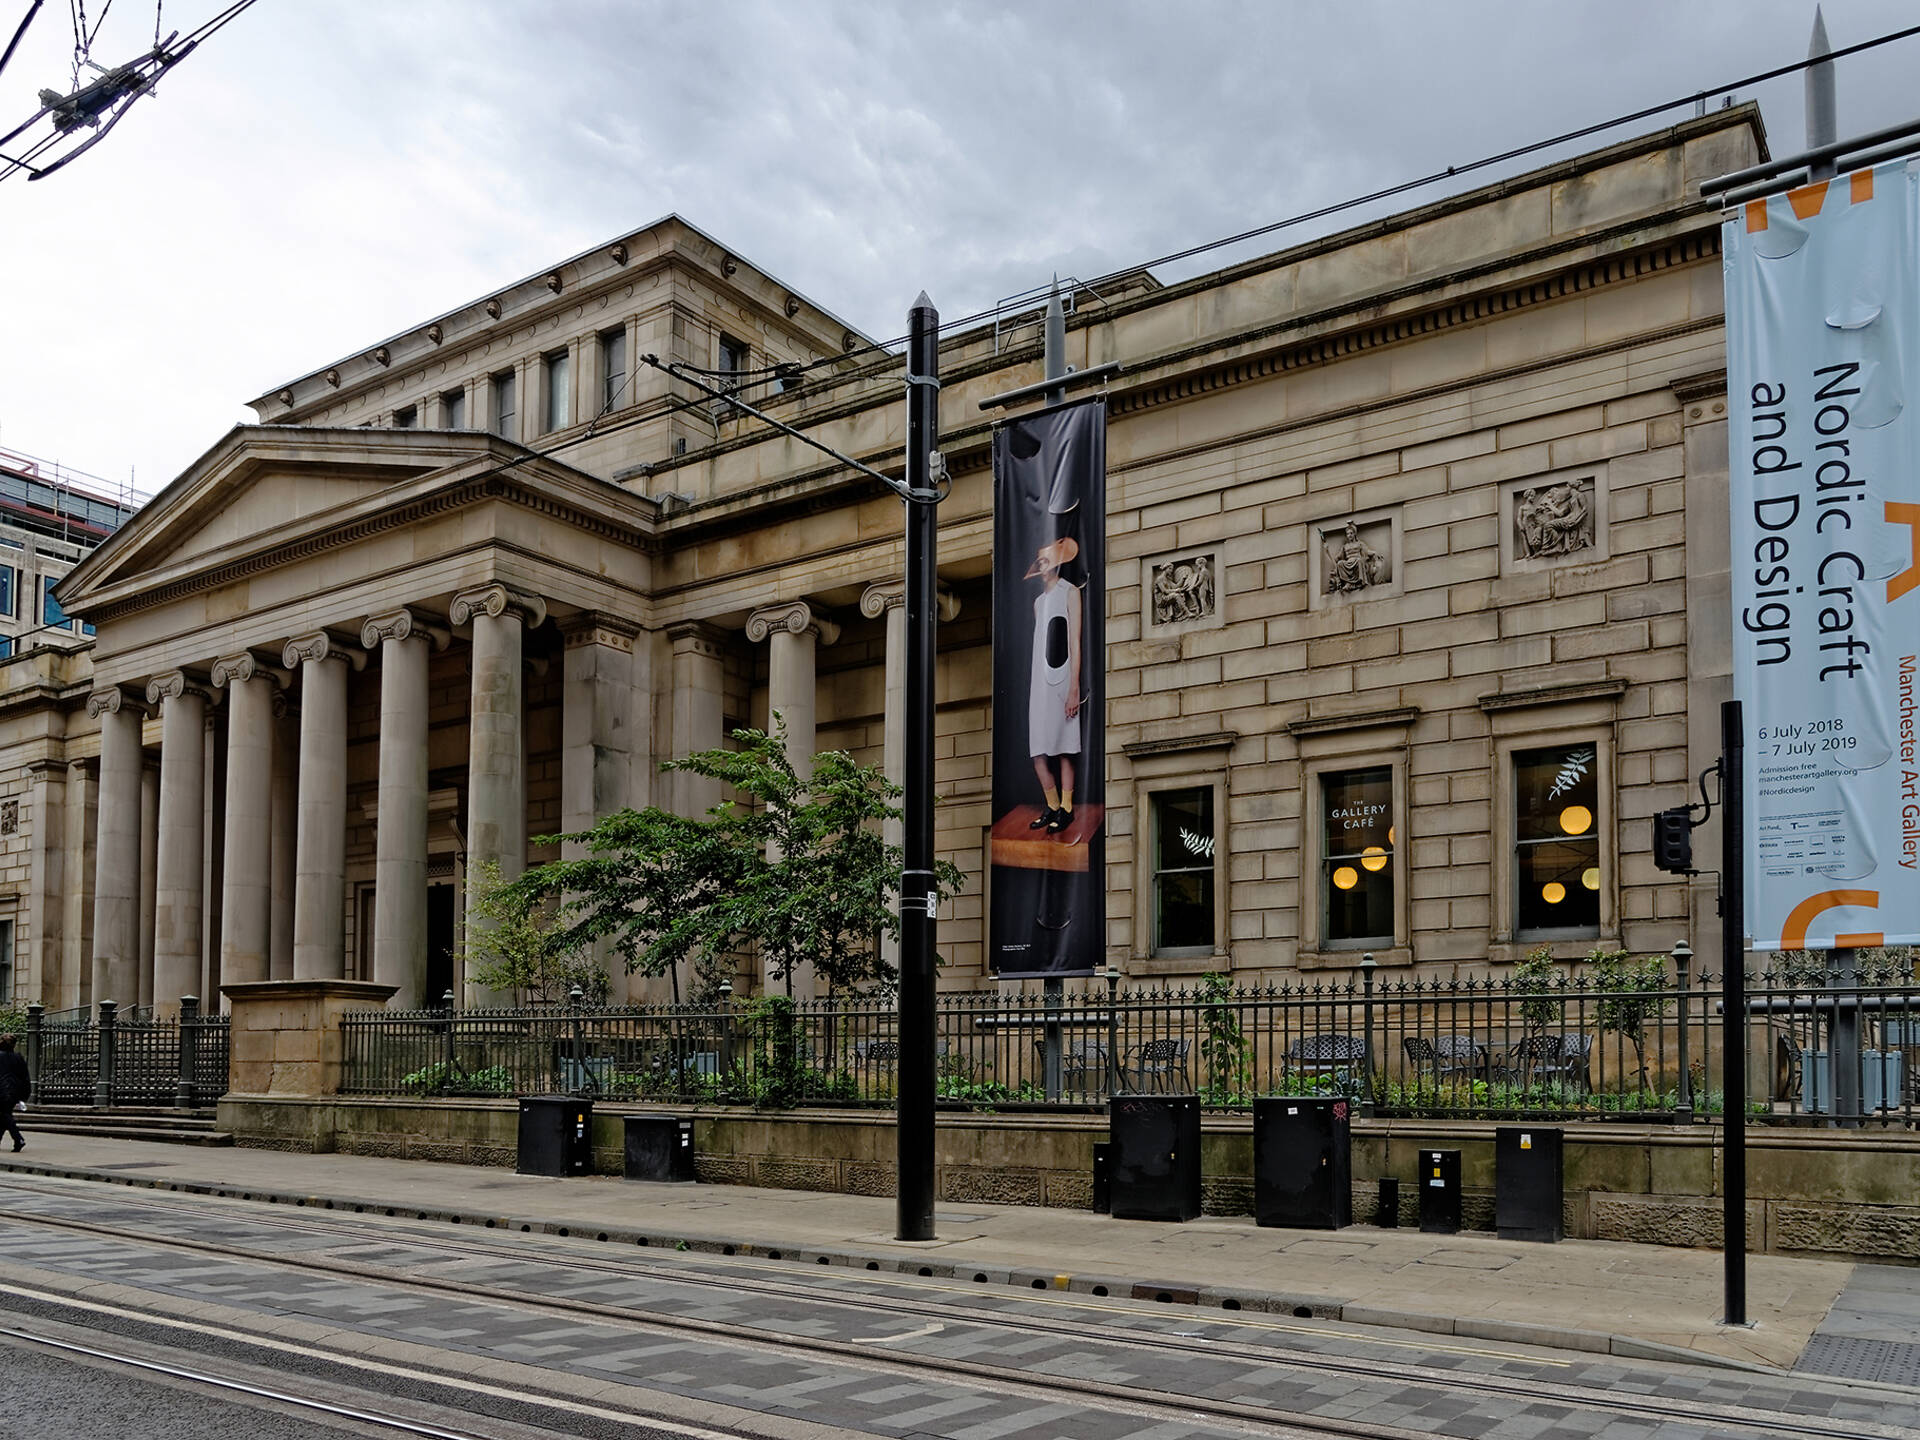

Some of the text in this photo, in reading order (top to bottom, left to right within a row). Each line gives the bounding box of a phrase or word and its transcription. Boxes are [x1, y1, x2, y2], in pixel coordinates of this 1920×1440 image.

[1743, 382, 1804, 666] and Design
[1813, 361, 1870, 682] Nordic Craft
[1758, 718, 1844, 740] 6 July 2018
[1772, 744, 1781, 756] 7
[1786, 741, 1817, 756] July
[1821, 736, 1857, 751] 2019
[1758, 762, 1817, 775] Admission free
[1898, 655, 1920, 870] Manchester Art Gallery
[1758, 769, 1858, 784] manchesterartgallery.org
[1758, 785, 1815, 797] #Nordicdesign
[1331, 804, 1386, 819] GALLERY
[1343, 816, 1375, 830] CAFÉ
